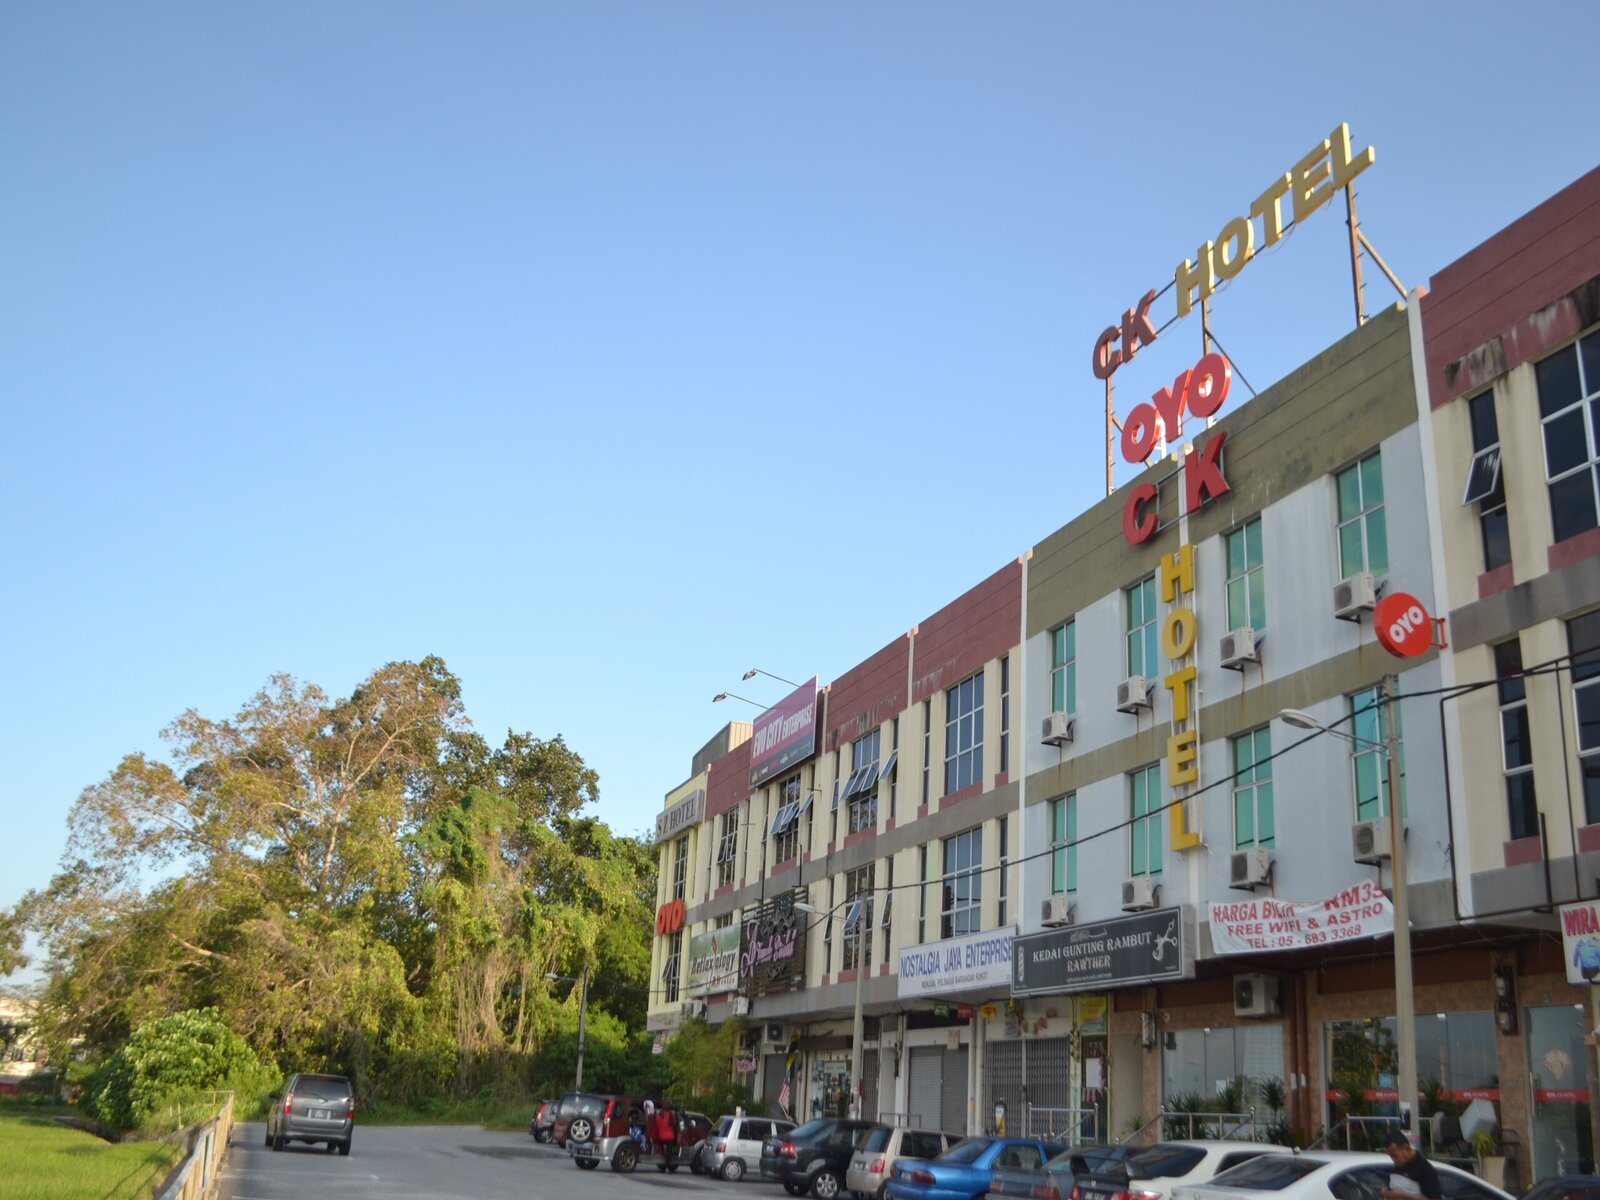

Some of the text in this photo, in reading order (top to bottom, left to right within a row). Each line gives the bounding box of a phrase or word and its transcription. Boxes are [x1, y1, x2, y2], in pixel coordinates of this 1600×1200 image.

[1093, 122, 1375, 379] CK HOTEL
[1121, 353, 1231, 463] OYO
[1390, 605, 1424, 643] OYO
[1161, 543, 1199, 851] HOTEL
[670, 798, 695, 829] HOTEL
[656, 898, 685, 936] OYO
[1212, 901, 1257, 923] HARGA
[1227, 922, 1263, 937] FREE
[1268, 919, 1300, 933] WIFI
[1307, 917, 1320, 930] &
[1327, 902, 1384, 926] ASTRO
[1562, 906, 1600, 937] WIRA
[1033, 931, 1152, 962] KEDAI GUNTING RAMBUT
[1278, 936, 1293, 947] 05
[1331, 925, 1361, 939] 3368
[900, 936, 1012, 978] NOSTALGIA JAYA ENTERPRISE
[1067, 955, 1111, 973] RAWTHER
